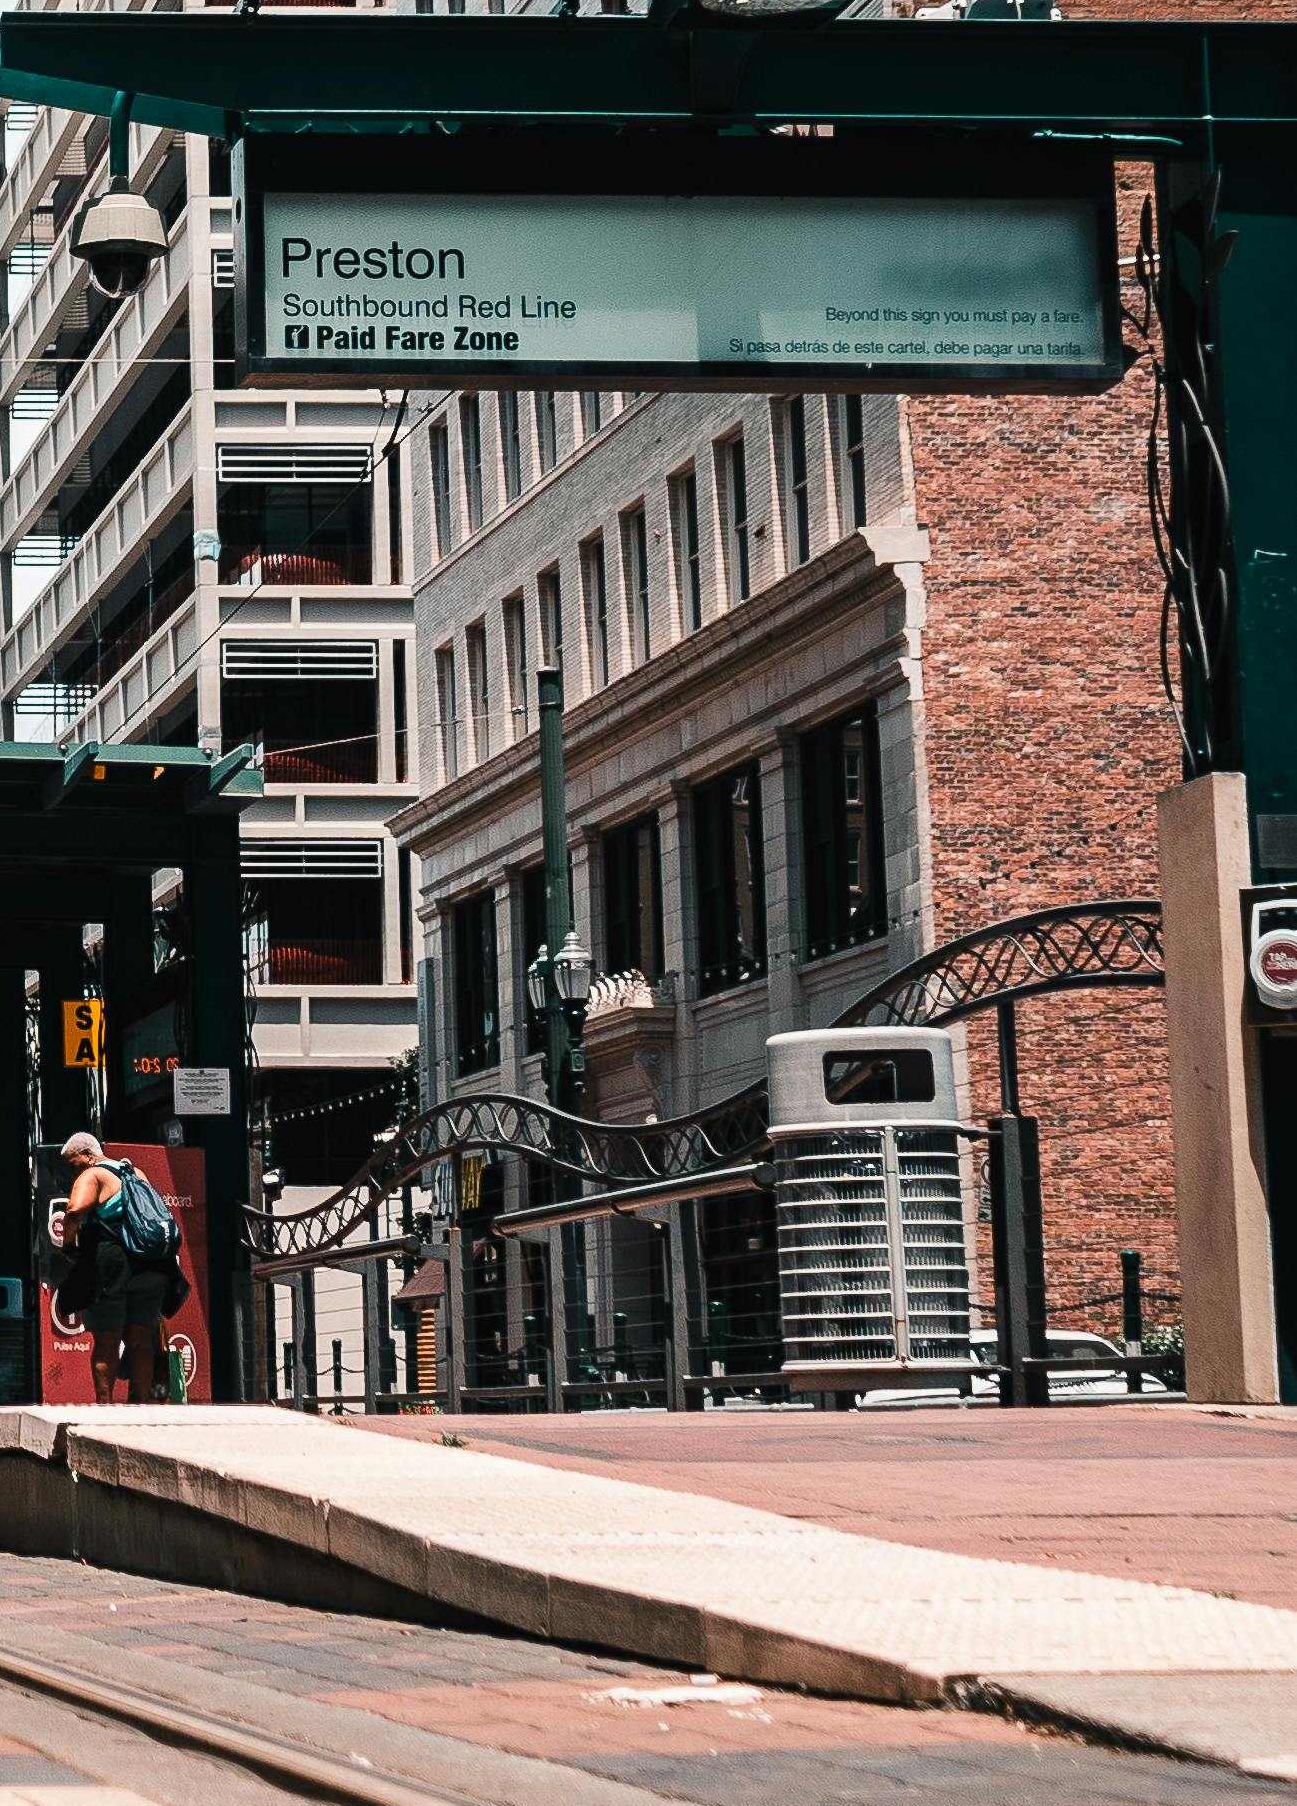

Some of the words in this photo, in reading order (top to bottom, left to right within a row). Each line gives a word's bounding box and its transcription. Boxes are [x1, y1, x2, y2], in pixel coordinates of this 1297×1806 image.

[281, 237, 466, 280] Preston
[282, 293, 449, 318] Southbound
[458, 294, 511, 319] Red
[520, 294, 577, 319] Line
[825, 306, 879, 324] Beyond
[883, 307, 908, 322] this
[910, 308, 940, 325] sign
[943, 310, 970, 325] you
[973, 309, 1008, 323] must
[1011, 311, 1037, 325] pay
[1040, 312, 1050, 323] a
[1053, 309, 1084, 324] fare.
[316, 325, 376, 351] Paid
[385, 325, 445, 351] Fare
[453, 326, 520, 351] Zone
[729, 338, 744, 353] Si
[747, 342, 781, 356] pasa
[784, 339, 829, 354] detrás
[832, 340, 851, 354] de
[854, 341, 884, 354] este
[887, 340, 930, 355] cartel,
[933, 340, 970, 355] debe
[973, 343, 1014, 358] pagar
[1017, 344, 1044, 356] una
[1047, 341, 1086, 356] tarifa.
